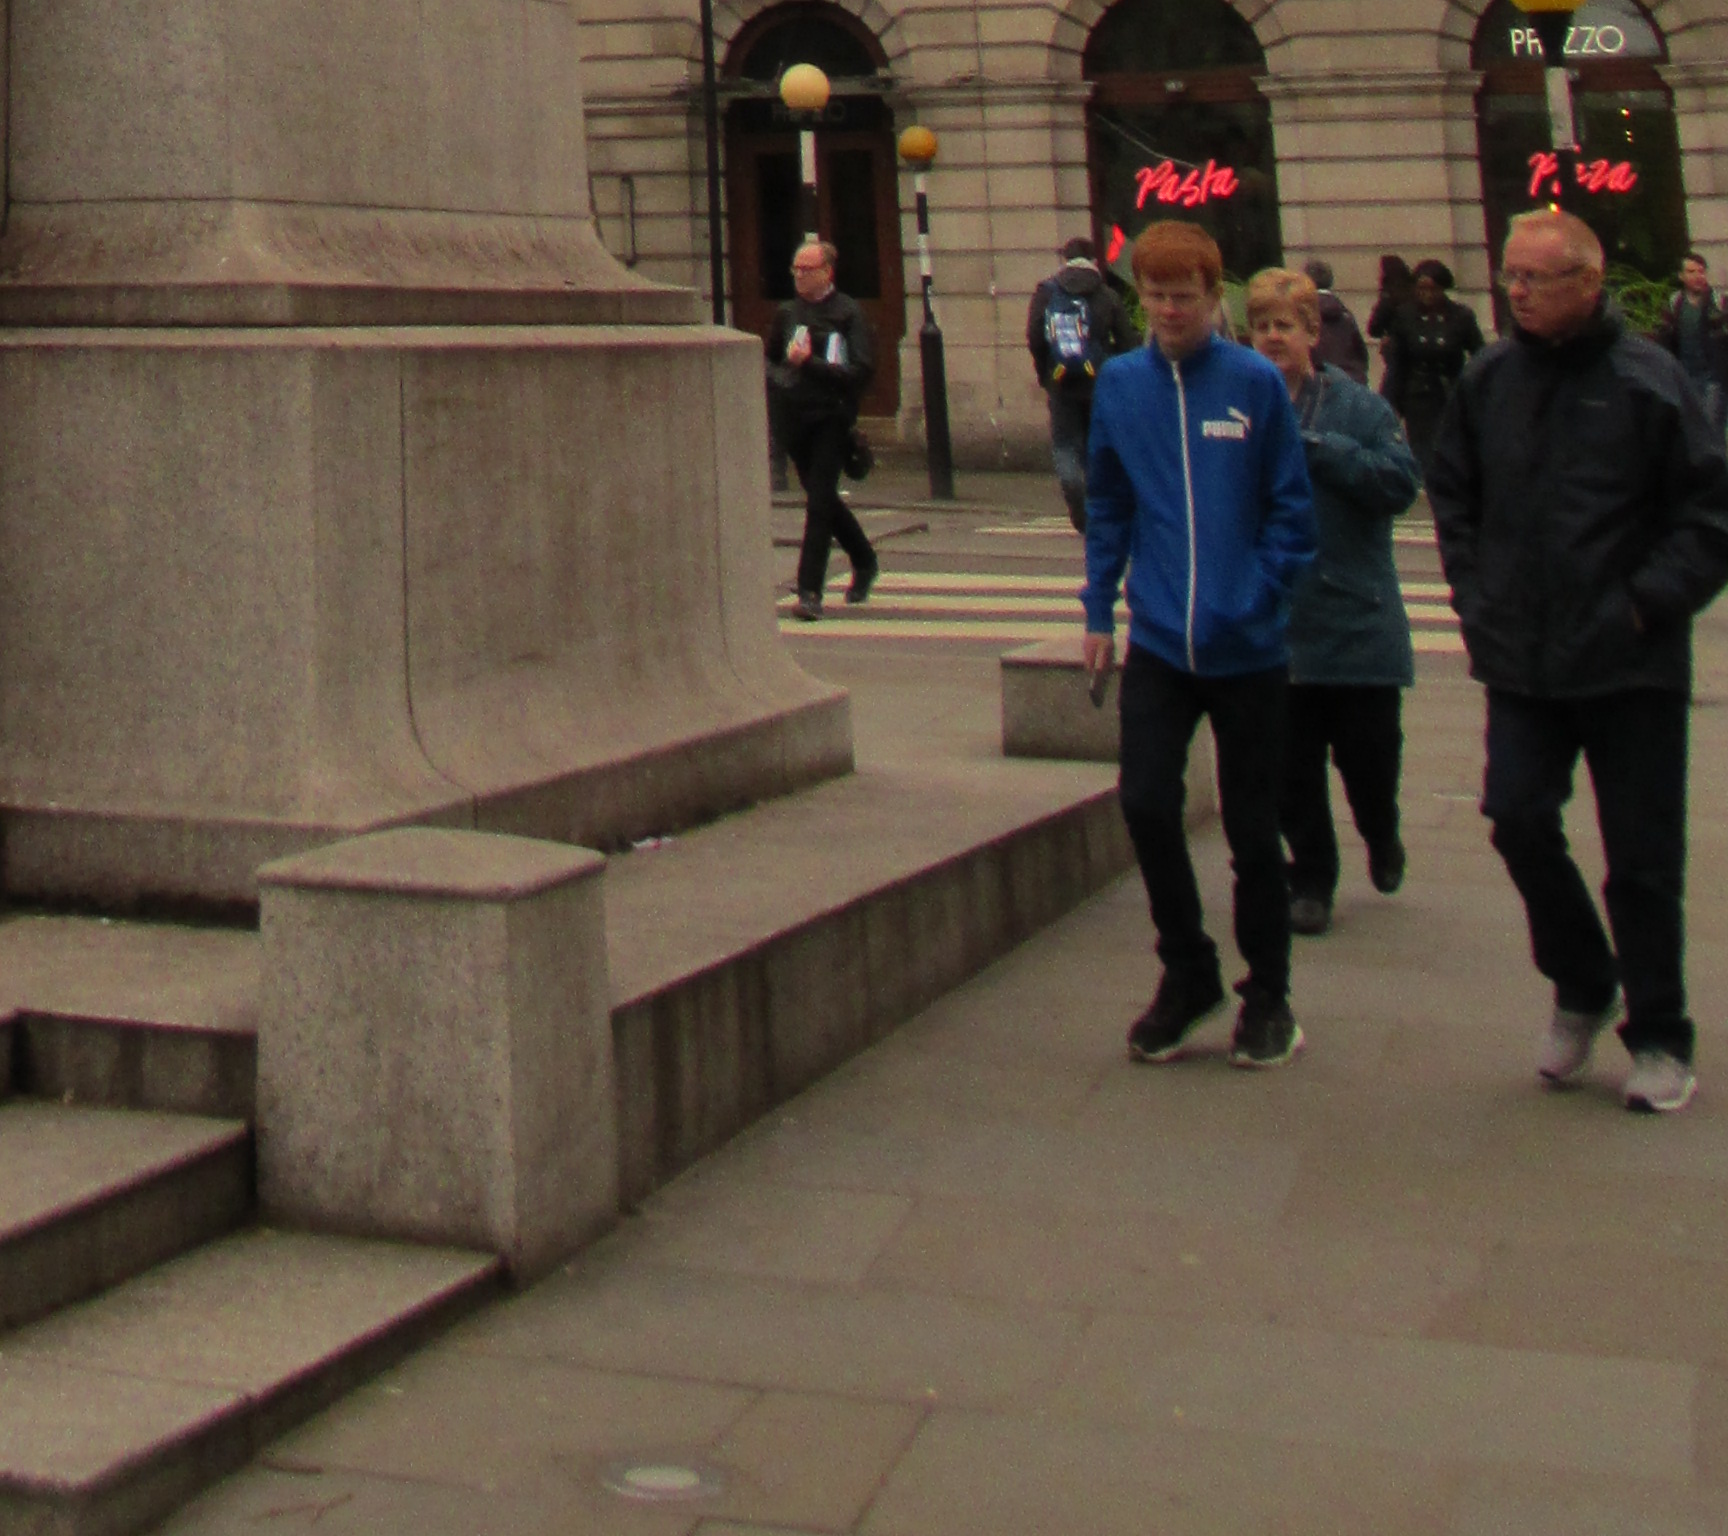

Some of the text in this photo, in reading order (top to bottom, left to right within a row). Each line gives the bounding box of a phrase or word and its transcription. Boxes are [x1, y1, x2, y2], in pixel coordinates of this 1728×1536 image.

[1510, 25, 1626, 56] PRZZO
[1135, 158, 1239, 211] Pasta
[1529, 143, 1638, 197] Pzza
